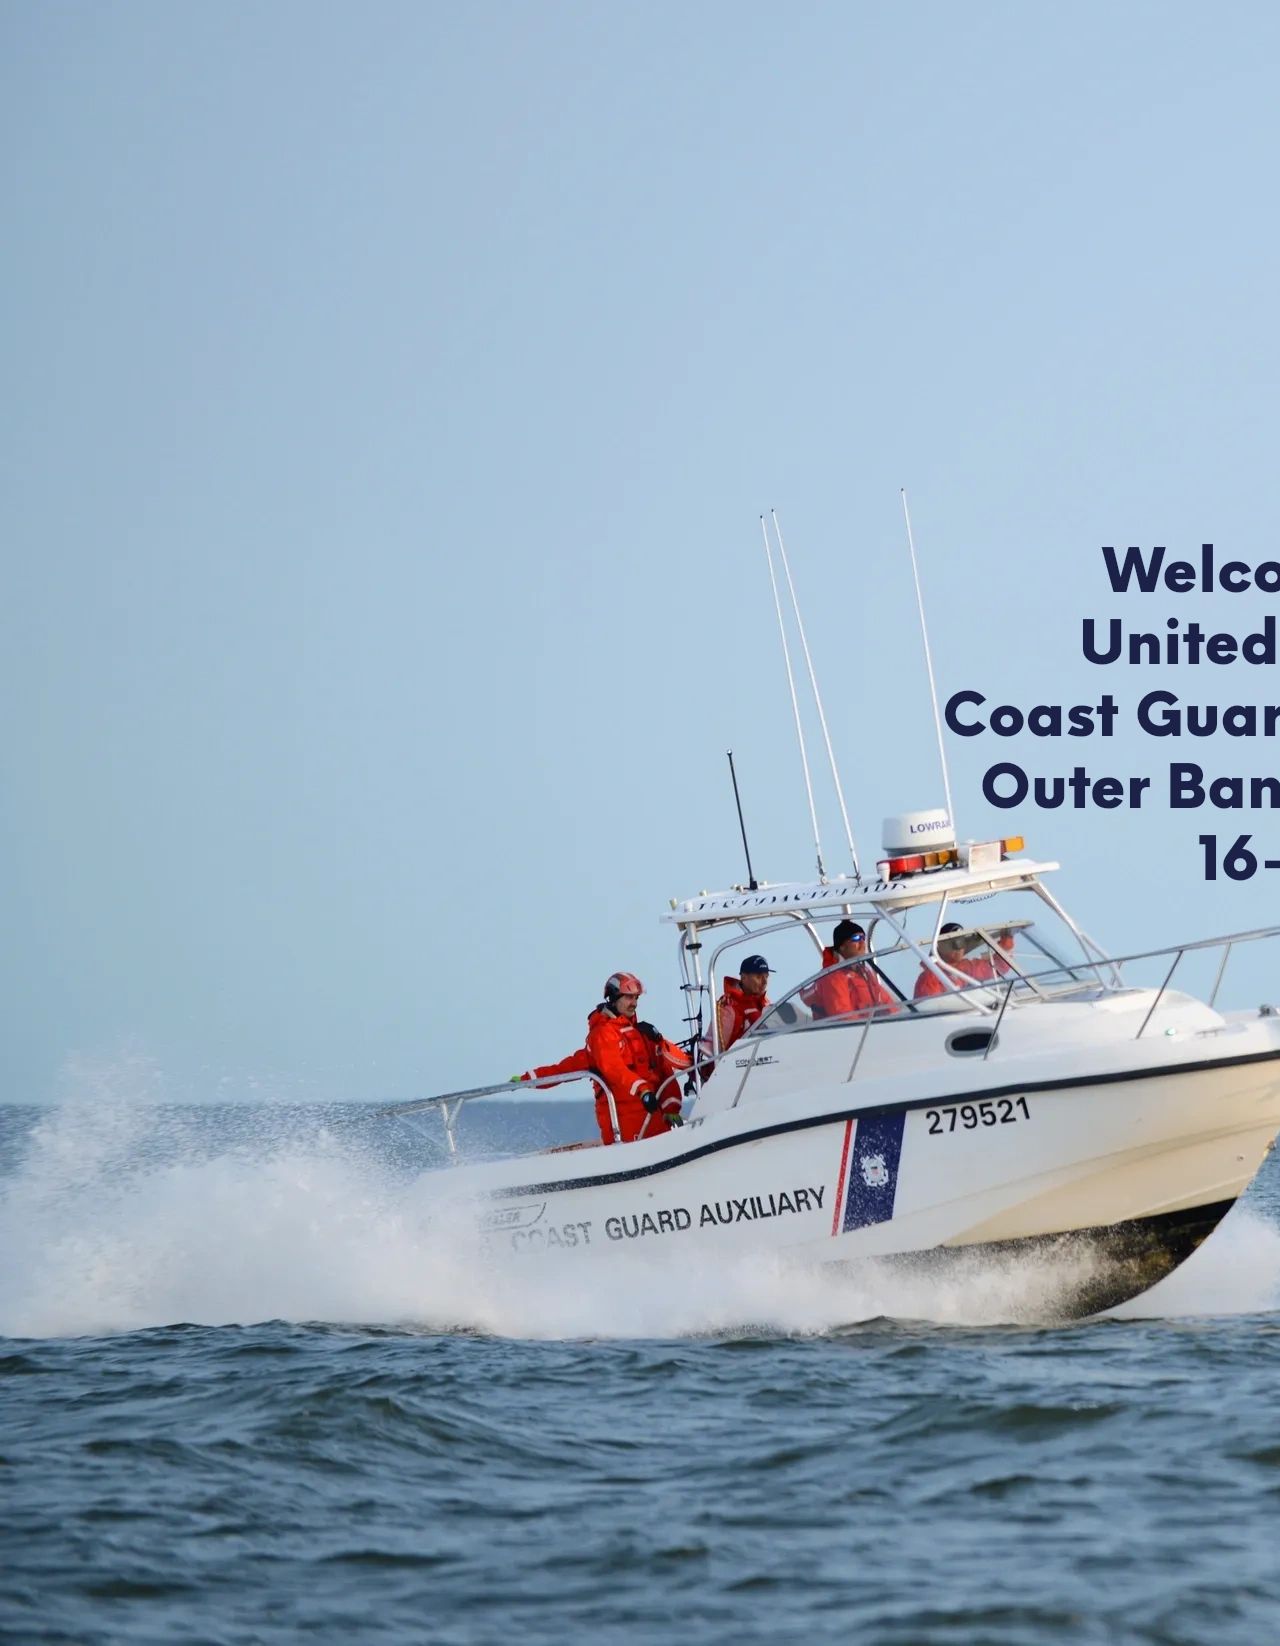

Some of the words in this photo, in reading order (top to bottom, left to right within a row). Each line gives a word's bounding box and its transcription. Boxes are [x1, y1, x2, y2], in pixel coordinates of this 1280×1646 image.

[925, 1096, 1031, 1135] 279521
[605, 1207, 692, 1241] GUARD
[699, 1185, 825, 1228] AUXILIARY
